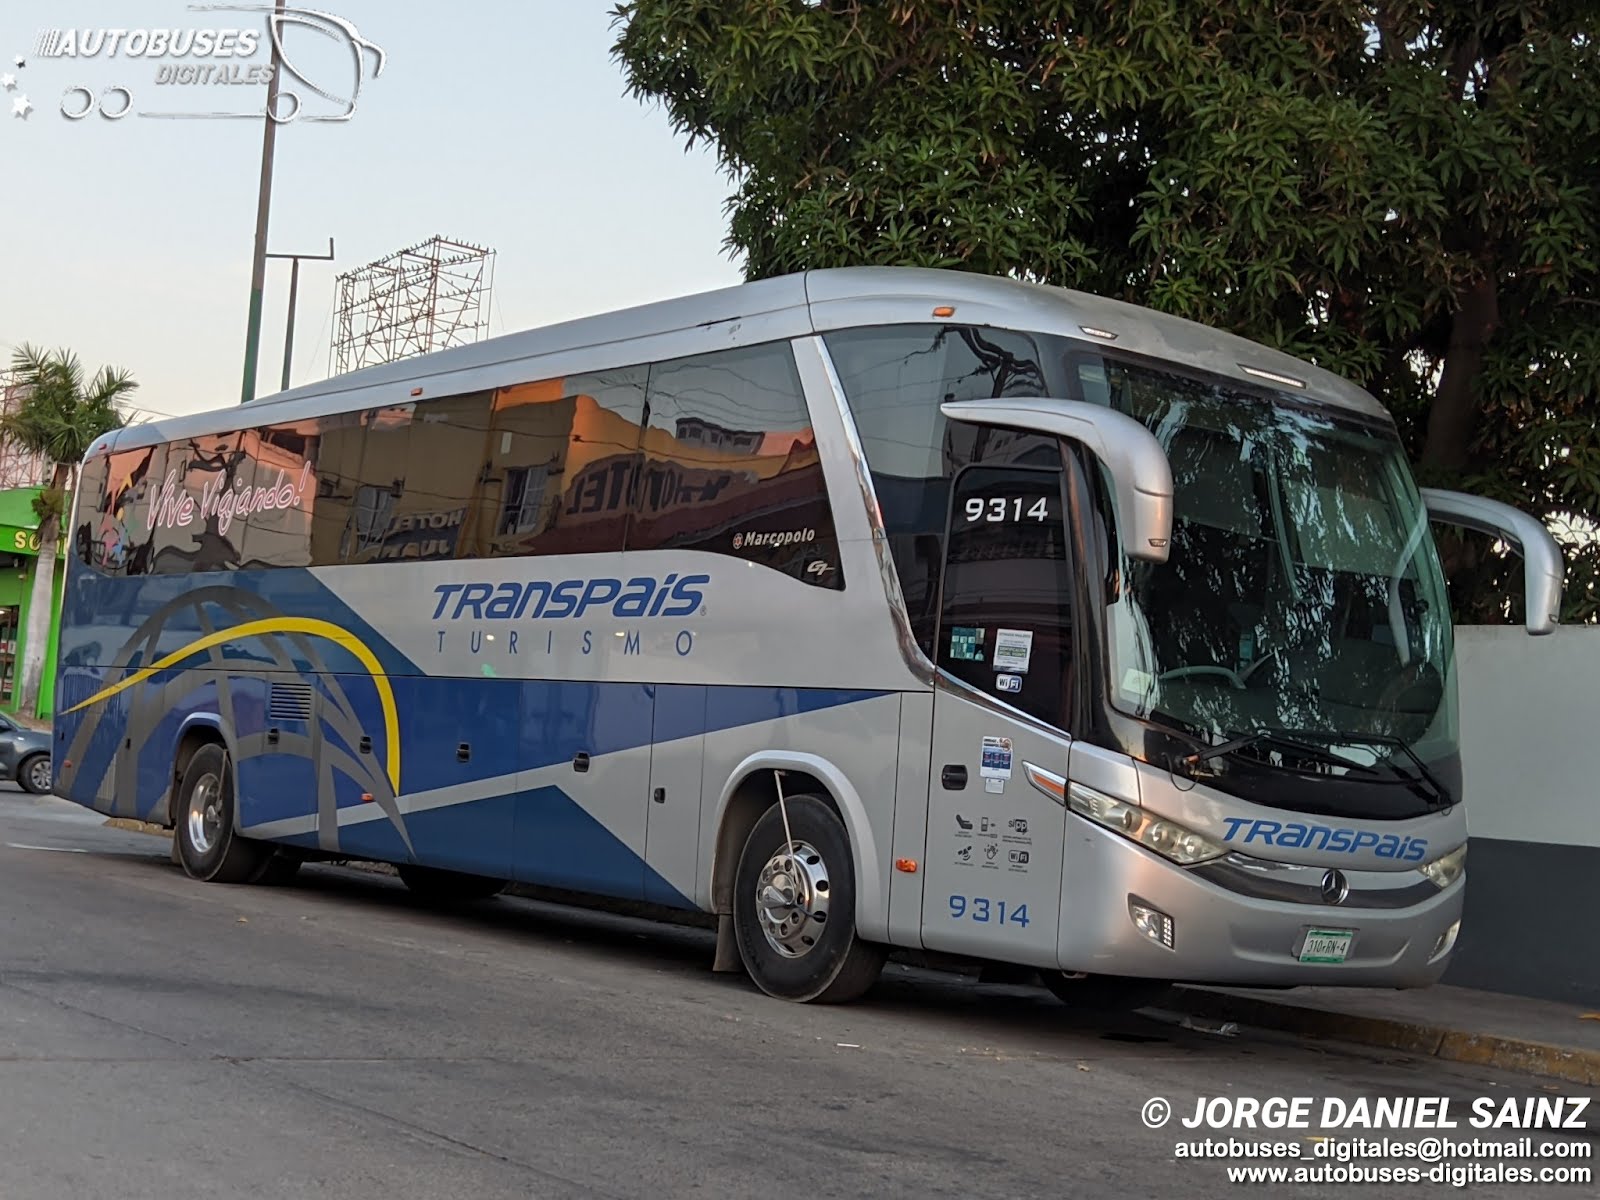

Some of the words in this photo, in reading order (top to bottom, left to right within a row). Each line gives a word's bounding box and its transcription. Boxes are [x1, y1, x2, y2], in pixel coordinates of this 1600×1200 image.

[965, 496, 1049, 522] 9314
[743, 527, 816, 547] Marcopolo
[437, 630, 694, 657] TURISMO
[949, 895, 1030, 928] 9314
